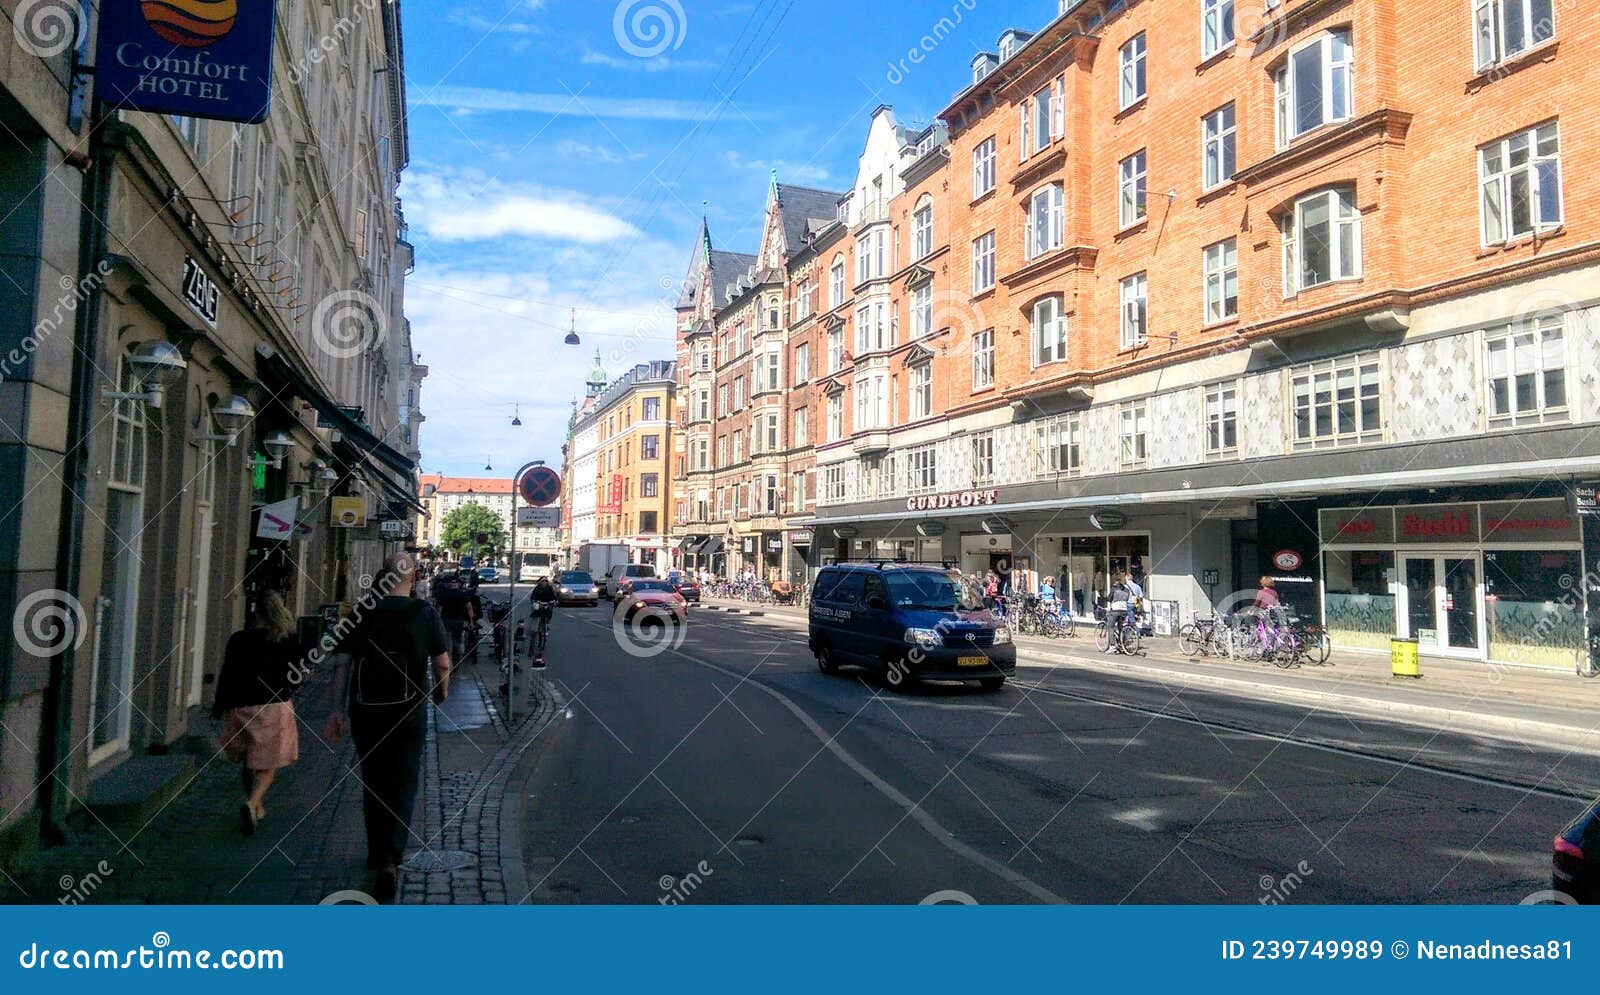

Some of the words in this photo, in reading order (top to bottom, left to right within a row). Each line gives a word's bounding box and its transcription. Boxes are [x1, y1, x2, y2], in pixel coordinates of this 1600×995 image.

[116, 42, 248, 82] Comfort
[138, 75, 229, 101] HOTEL
[906, 489, 997, 511] GUNDTOFT
[1486, 553, 1496, 561] 24
